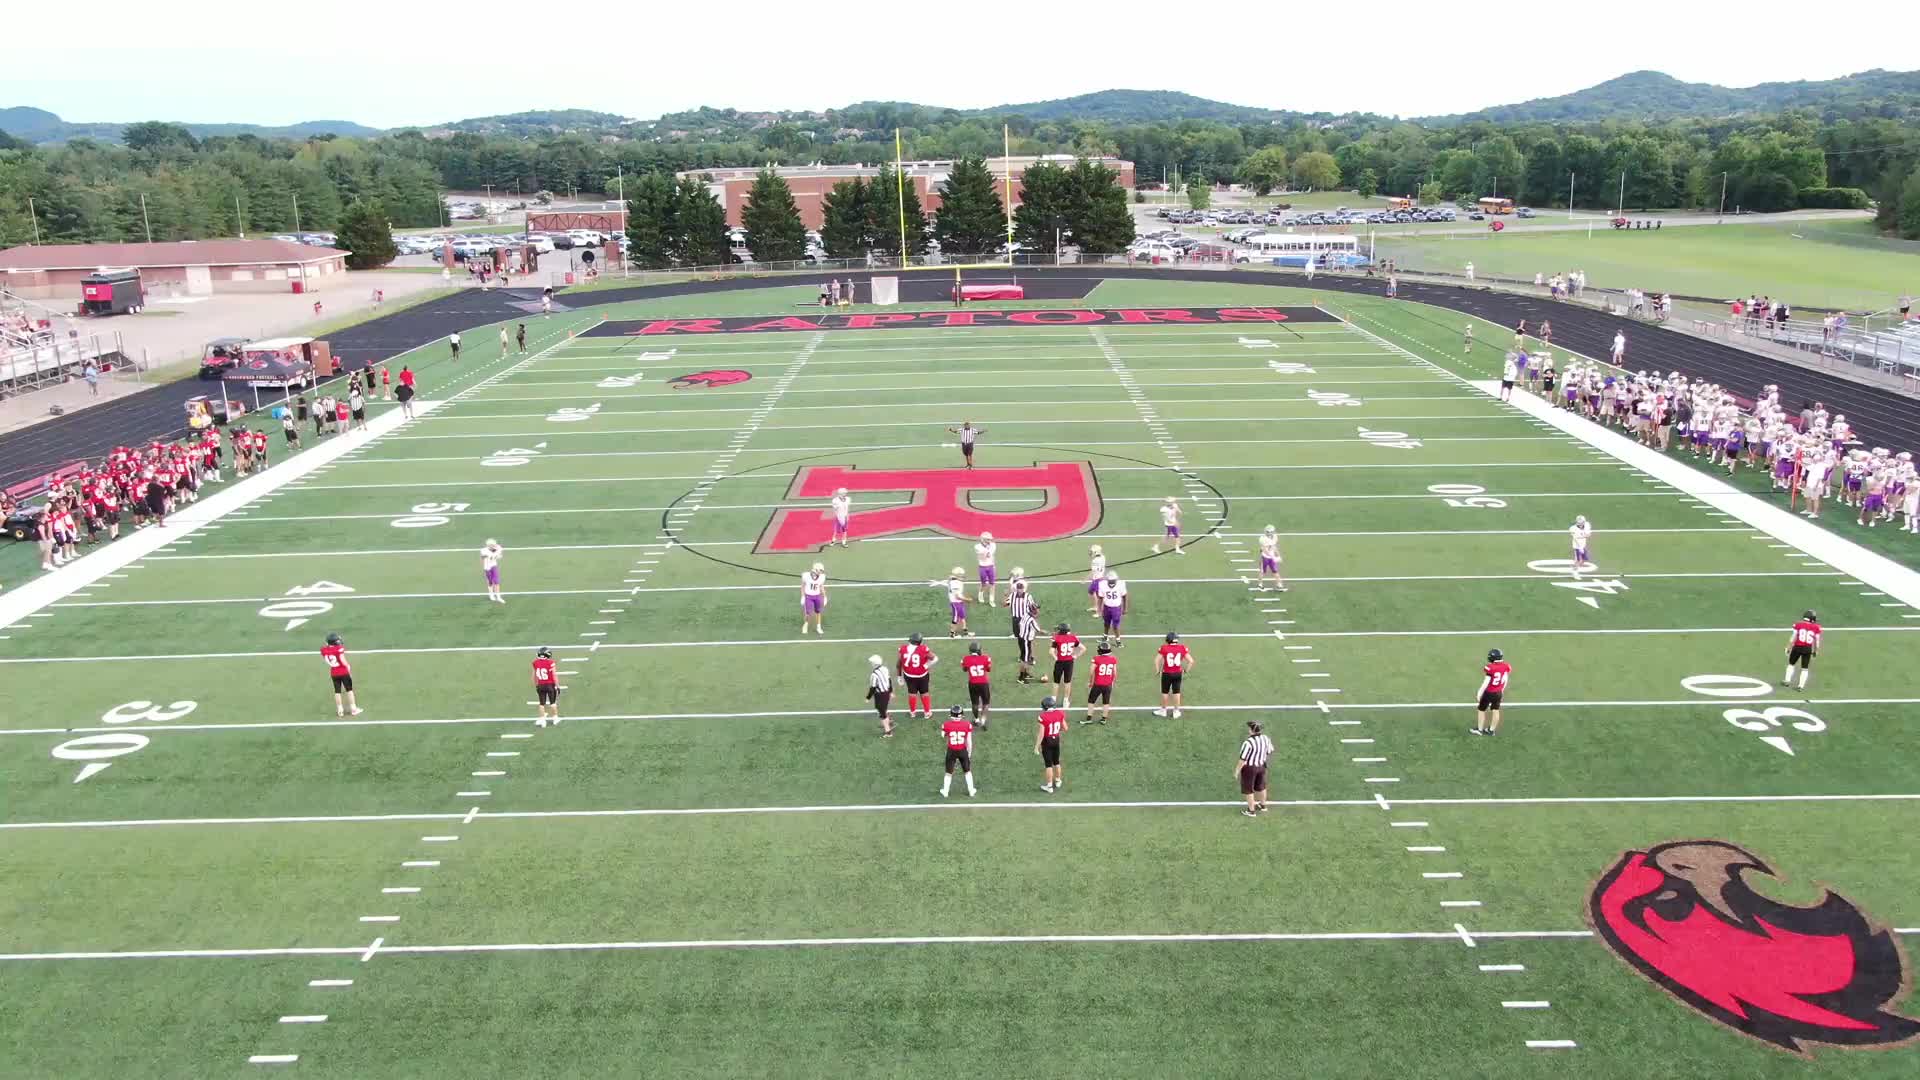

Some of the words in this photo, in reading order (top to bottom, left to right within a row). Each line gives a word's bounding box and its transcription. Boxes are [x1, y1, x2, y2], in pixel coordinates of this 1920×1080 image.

[624, 307, 1289, 335] RAPTORS
[1427, 483, 1508, 508] 50
[389, 502, 471, 528] 50
[753, 461, 1104, 554] R
[1526, 558, 1631, 595] 40
[258, 580, 356, 618] 40
[1799, 628, 1815, 644] 86
[1060, 642, 1076, 657] 95
[1166, 652, 1182, 667] 64
[903, 653, 921, 668] 79
[969, 664, 985, 677] 65
[1098, 663, 1115, 676] 96
[1680, 674, 1828, 732] 30
[51, 700, 198, 760] 30
[949, 731, 966, 745] 25
[1048, 721, 1061, 735] 10
